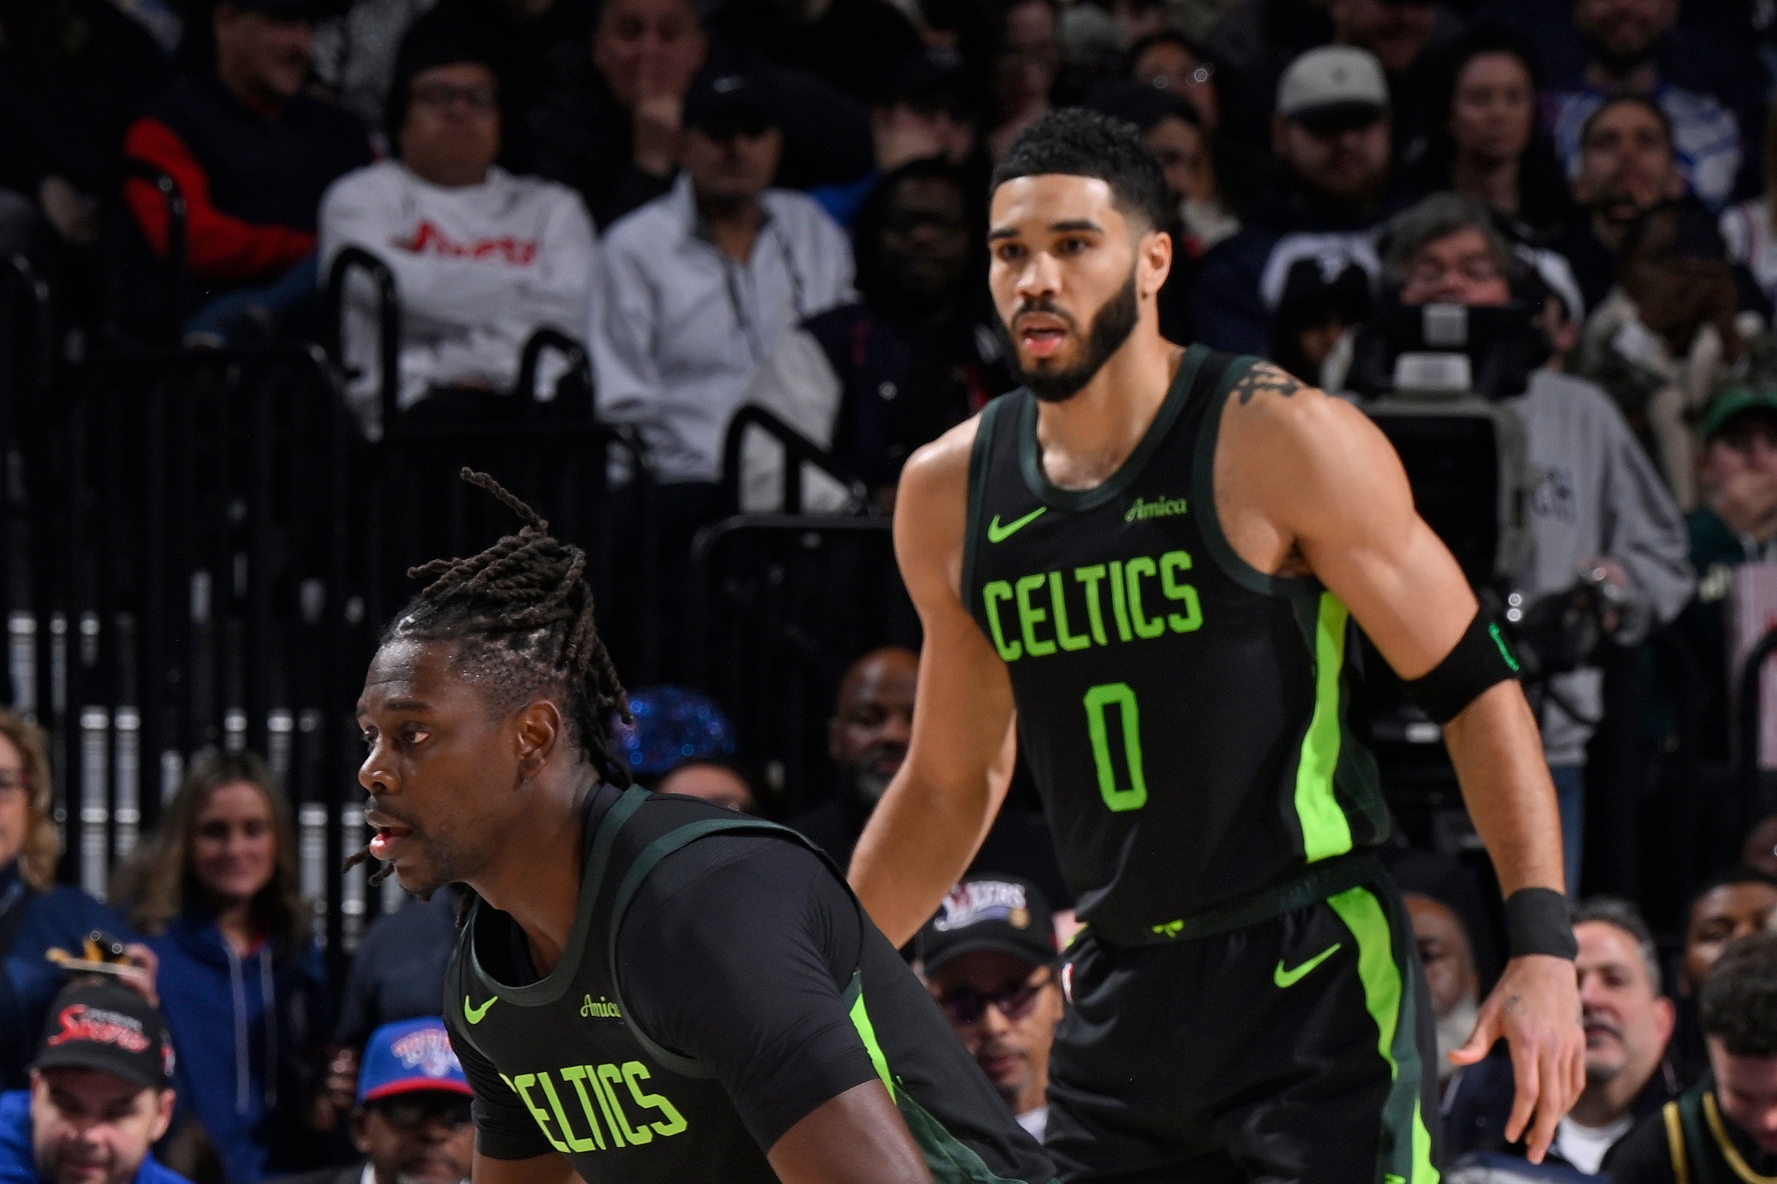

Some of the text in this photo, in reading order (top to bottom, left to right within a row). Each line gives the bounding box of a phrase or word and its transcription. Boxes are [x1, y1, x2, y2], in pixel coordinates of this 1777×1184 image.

[1124, 496, 1187, 522] Amica
[983, 550, 1203, 663] CELTICS
[1083, 682, 1148, 812] 0
[498, 1060, 688, 1153] ELTICS
